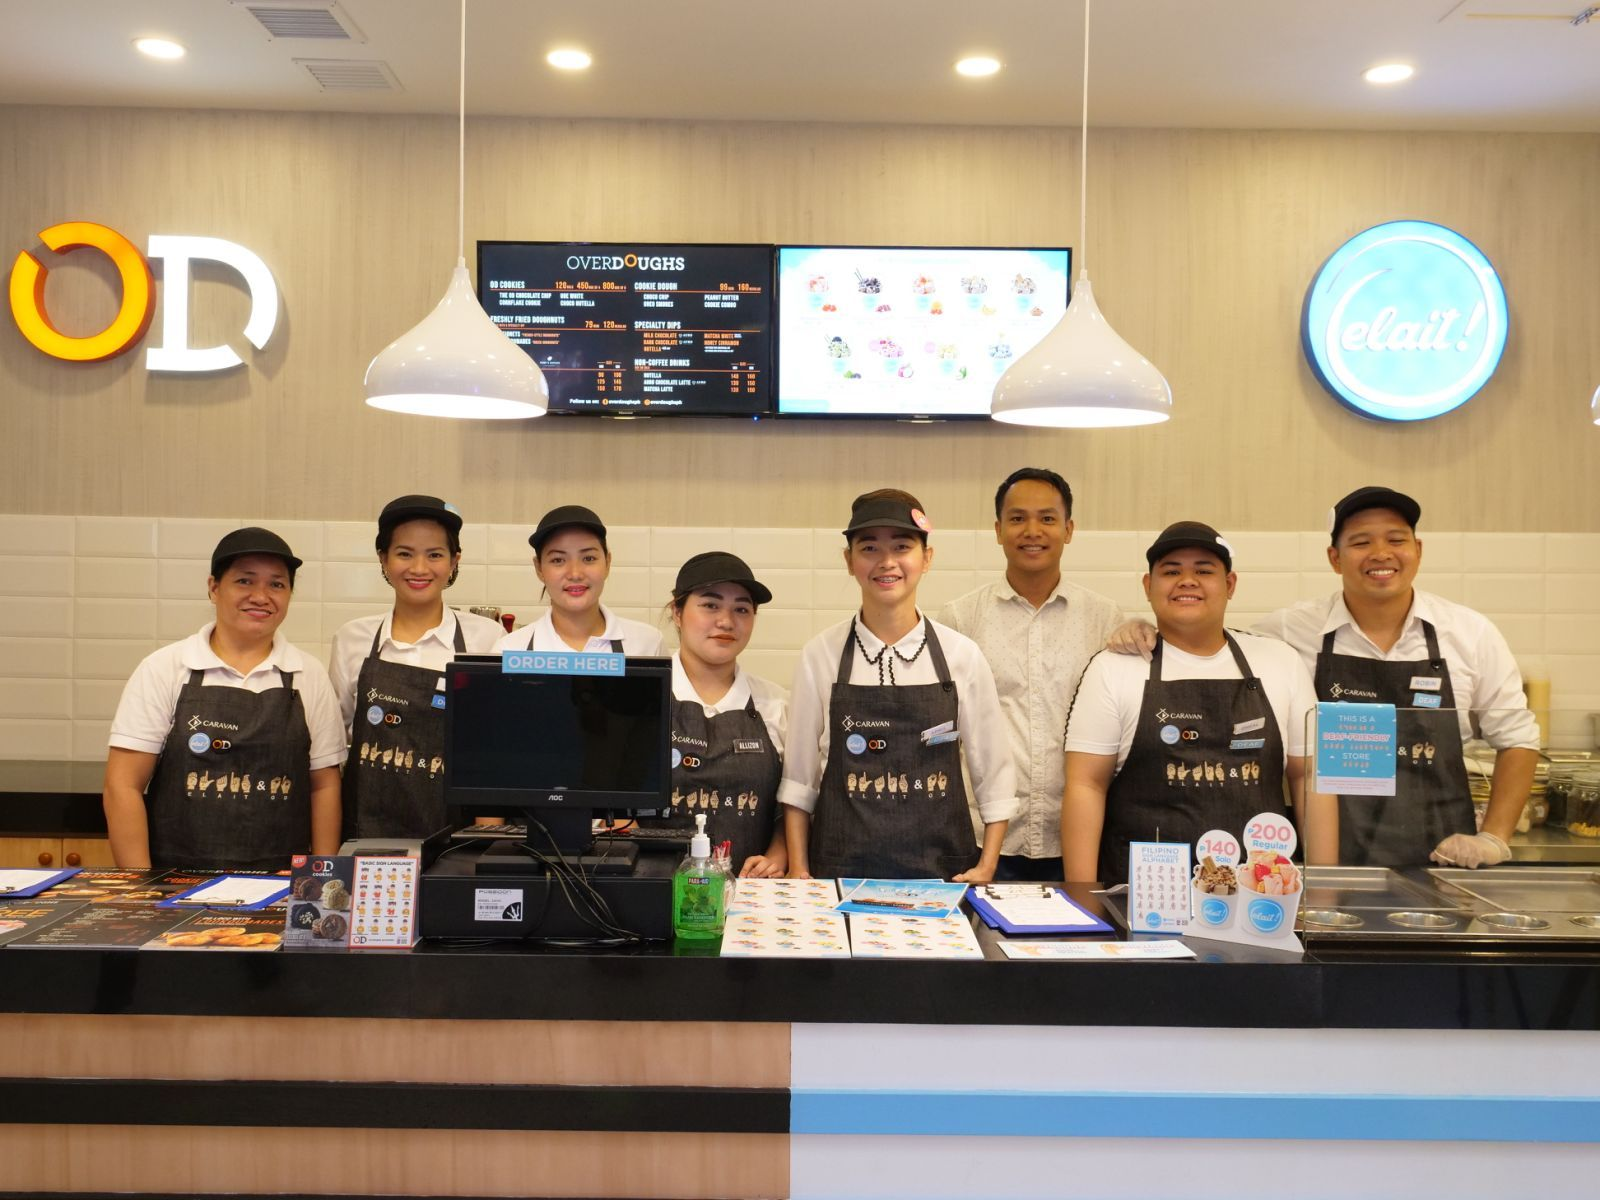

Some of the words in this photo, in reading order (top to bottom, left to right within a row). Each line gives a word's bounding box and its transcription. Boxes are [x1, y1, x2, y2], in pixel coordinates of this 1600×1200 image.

[566, 254, 686, 271] OVERDOUGHS
[499, 281, 526, 289] COOKIES
[555, 282, 567, 290] 120
[634, 282, 656, 290] COOKIE
[657, 282, 678, 290] DOUGH
[9, 221, 279, 372] OD
[634, 321, 666, 329] SPECIALTY
[634, 359, 668, 367] NON-COFFEE
[669, 359, 690, 367] DRINKS
[508, 656, 568, 669] ORDER
[574, 658, 619, 671] HERE
[1343, 688, 1377, 698] CARAVAN
[378, 694, 409, 706] CARAVAN
[384, 714, 401, 725] OD
[1170, 712, 1203, 720] CARAVAN
[1338, 714, 1357, 722] THIS
[202, 720, 239, 731] CARAVAN
[855, 720, 890, 728] CARAVAN
[1181, 730, 1199, 740] OD
[1322, 731, 1391, 742] DEAF-FRIENDLY
[212, 739, 231, 750] OD
[677, 735, 708, 748] CARAVAN
[868, 739, 887, 750] OD
[1343, 752, 1370, 760] STORE
[682, 756, 700, 767] OD
[1252, 840, 1288, 850] Regular
[1141, 846, 1180, 855] FILIPINO
[1215, 855, 1231, 863] Solo
[312, 860, 334, 872] OD
